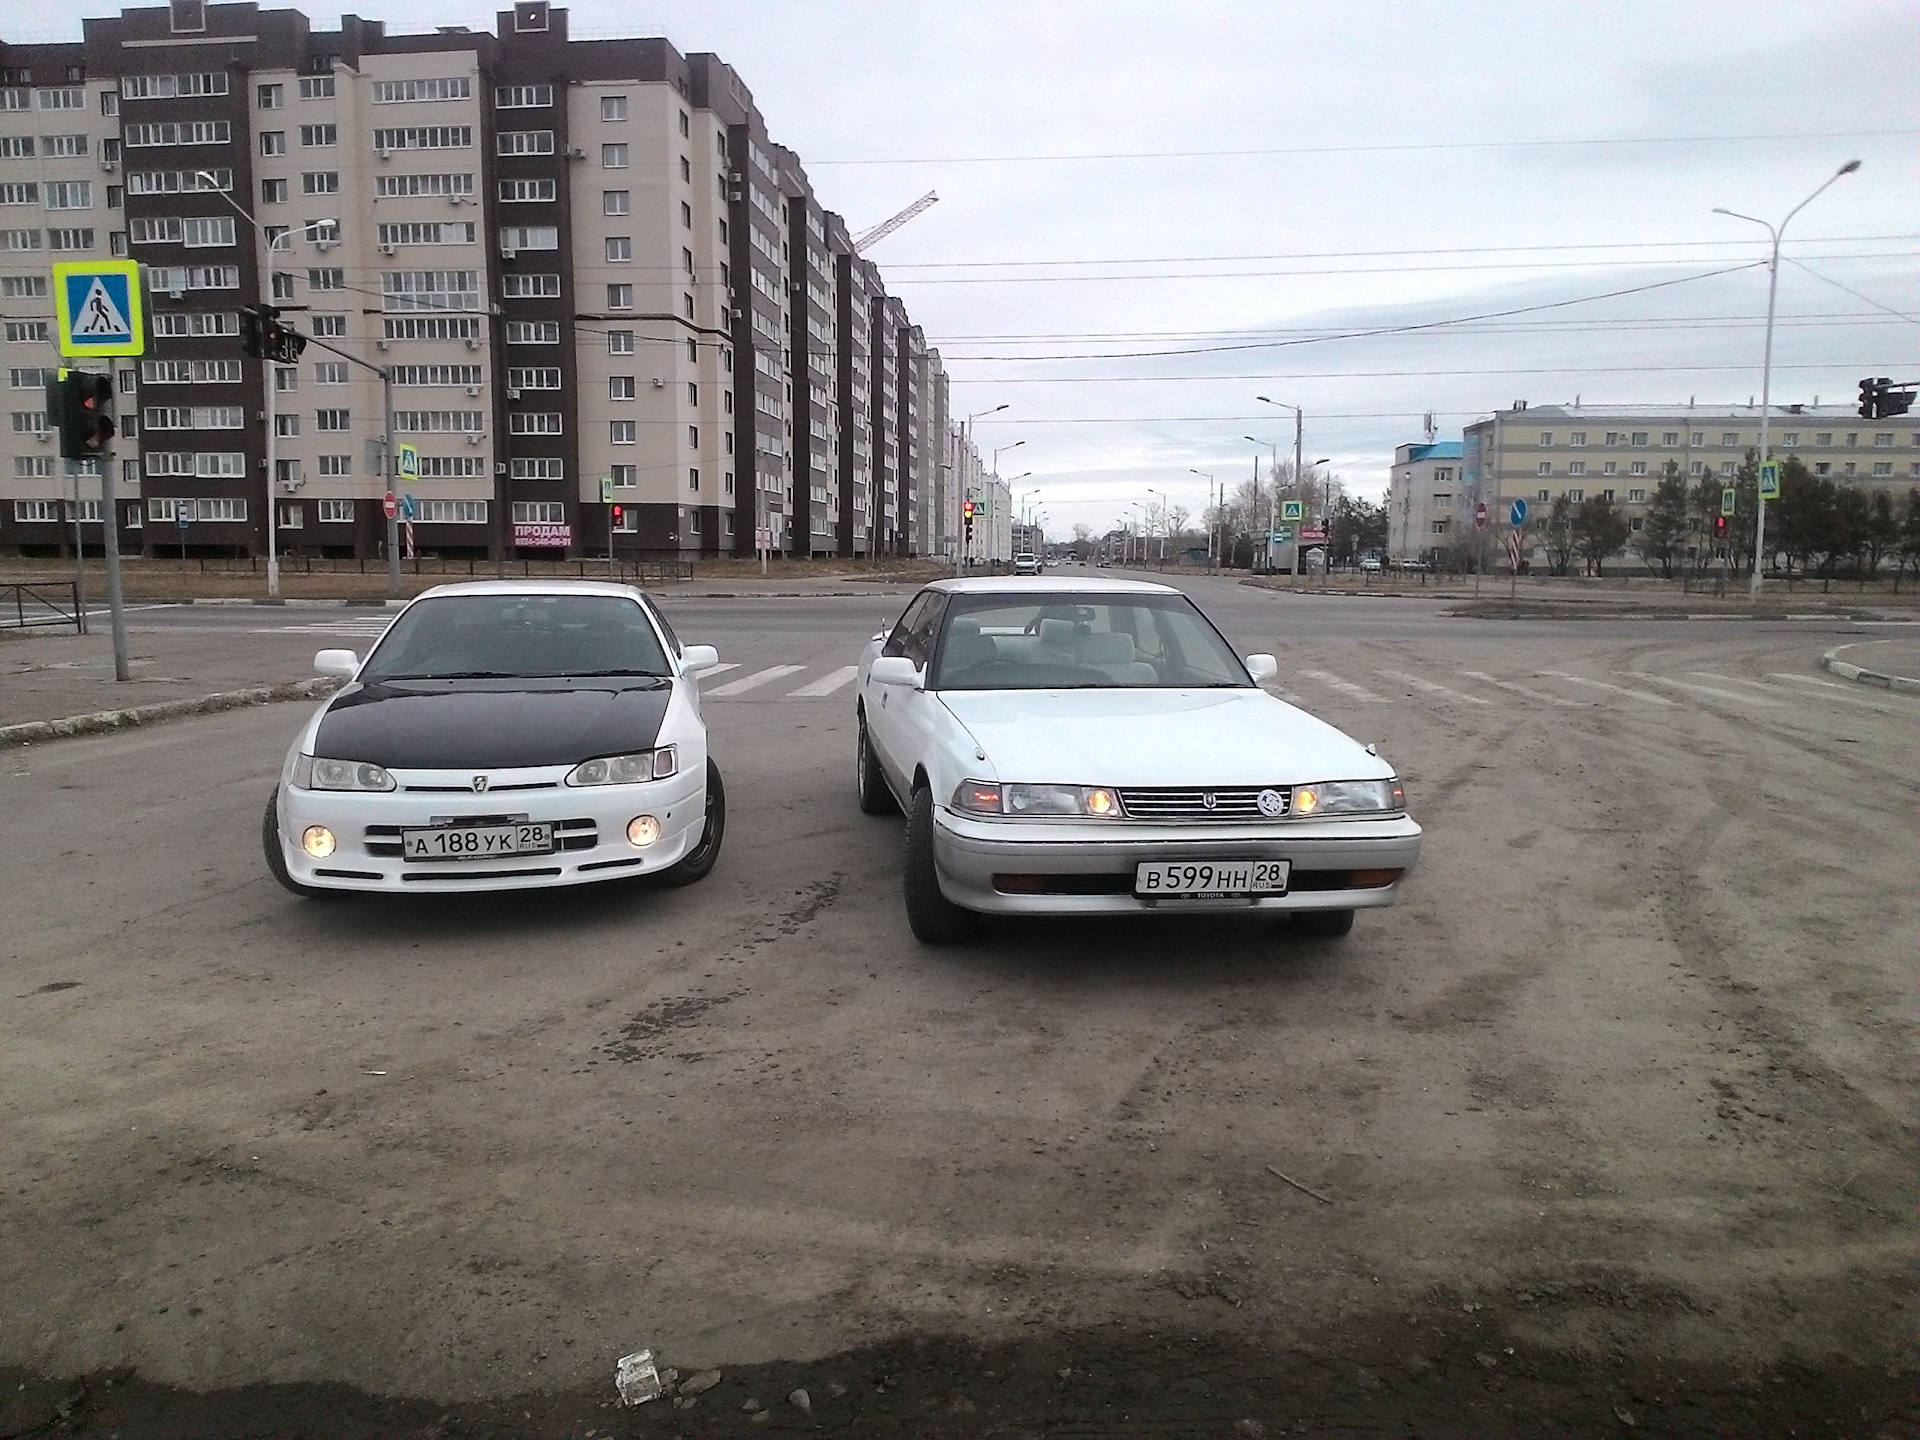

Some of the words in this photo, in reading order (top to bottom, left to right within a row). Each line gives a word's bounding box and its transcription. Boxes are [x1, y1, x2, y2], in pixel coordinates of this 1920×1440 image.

[515, 526, 571, 538] ПРОДАМ
[519, 826, 543, 843] 28
[1255, 864, 1280, 882] 28
